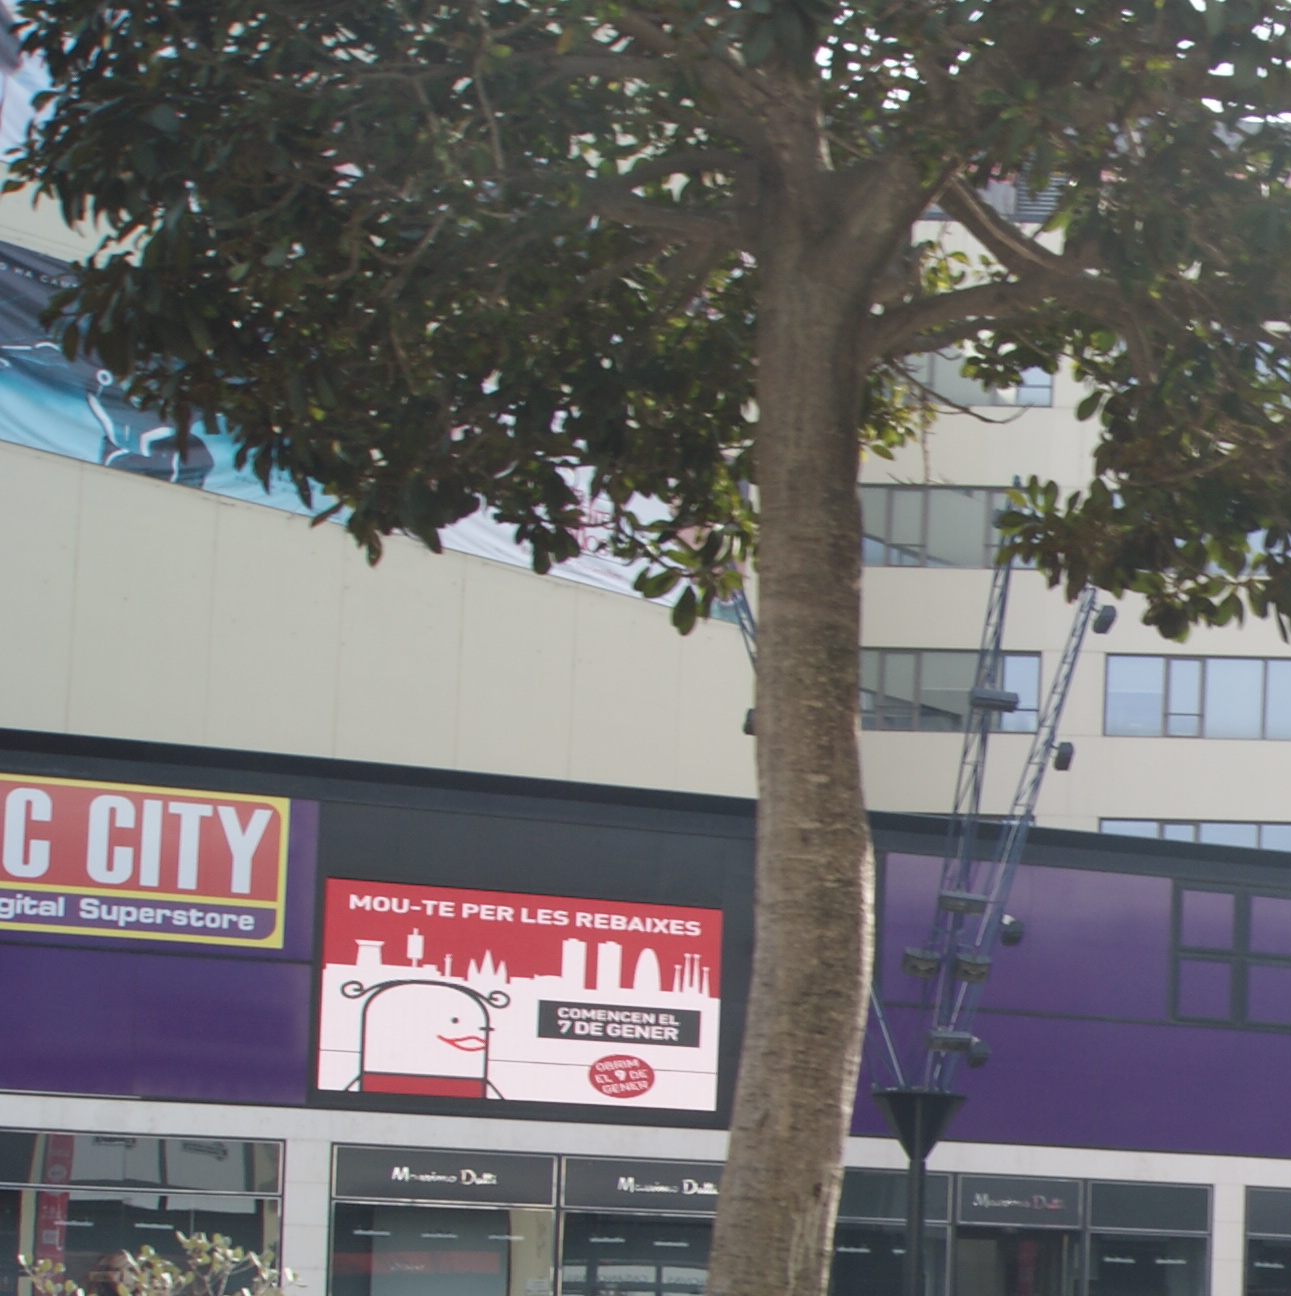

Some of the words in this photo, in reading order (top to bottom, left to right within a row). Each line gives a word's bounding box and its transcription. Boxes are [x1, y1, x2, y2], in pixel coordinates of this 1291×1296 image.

[87, 794, 273, 894] CITY
[79, 898, 255, 931] Superstore
[349, 894, 456, 917] MOU-TE
[462, 904, 515, 922] PER
[521, 909, 569, 926] LES
[576, 914, 702, 937] REBAIXES
[557, 1006, 657, 1024] COMENCEN
[658, 1013, 681, 1027] EL
[557, 1020, 572, 1035] 7
[573, 1021, 604, 1036] DE
[605, 1023, 680, 1042] GENER
[613, 1069, 628, 1082] 9
[629, 1068, 650, 1081] DE
[601, 1080, 651, 1095] GENER
